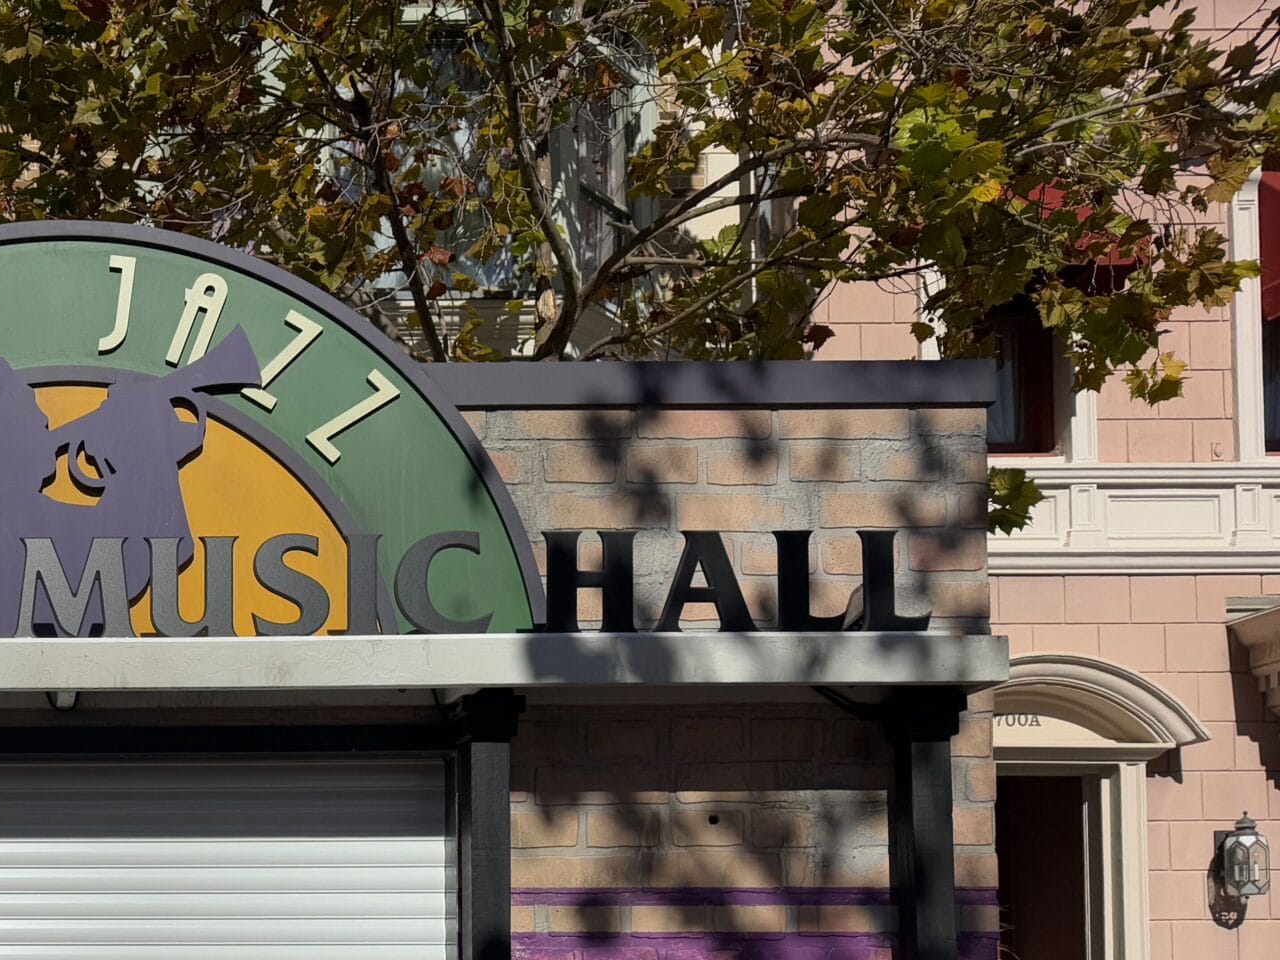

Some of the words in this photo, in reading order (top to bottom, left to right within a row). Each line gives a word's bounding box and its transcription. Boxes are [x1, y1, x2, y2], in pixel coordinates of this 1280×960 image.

[97, 254, 401, 464] JAZZ
[12, 530, 496, 638] MUSIC
[541, 529, 933, 634] HALL
